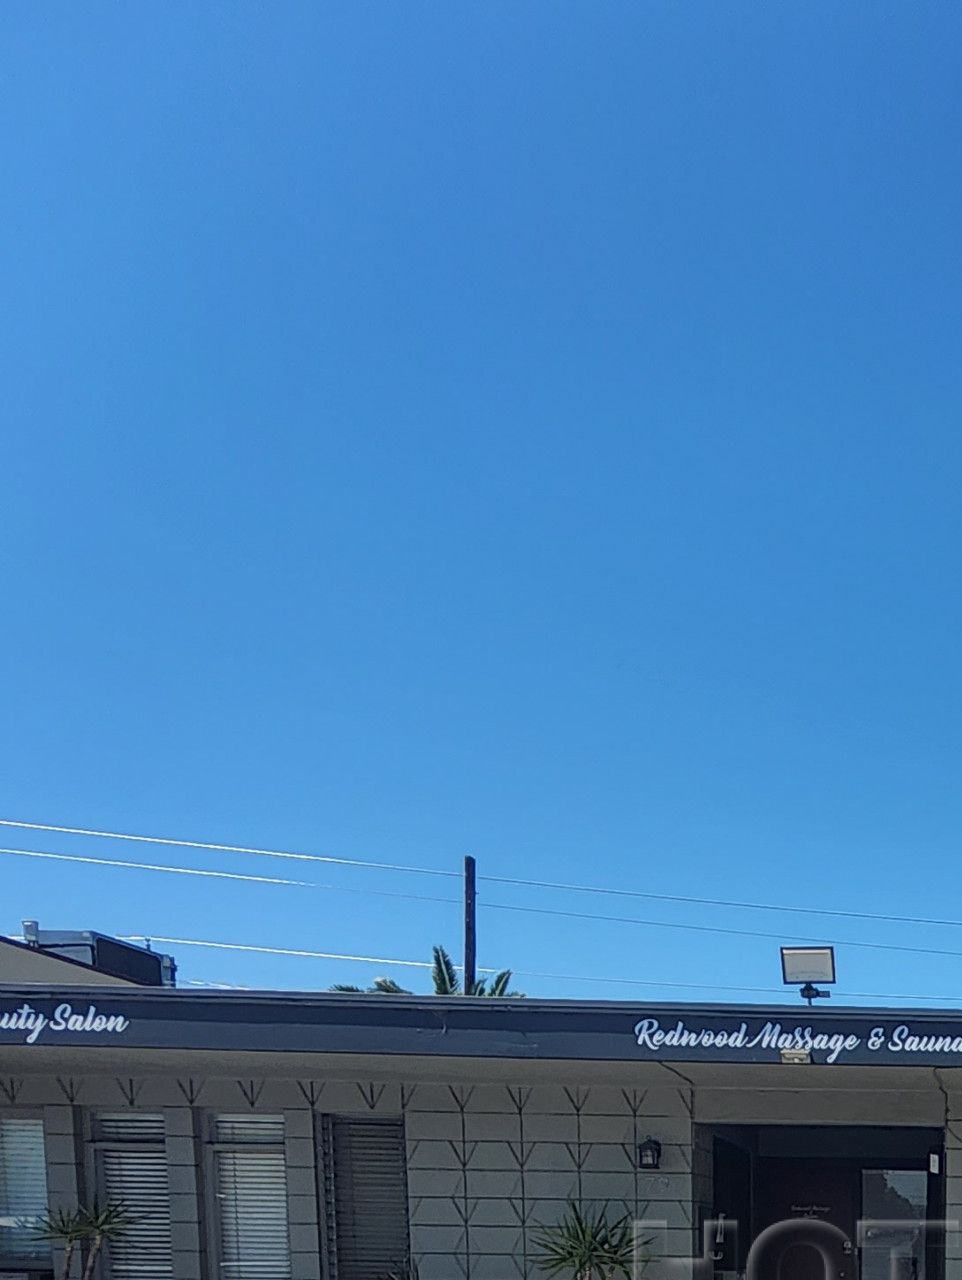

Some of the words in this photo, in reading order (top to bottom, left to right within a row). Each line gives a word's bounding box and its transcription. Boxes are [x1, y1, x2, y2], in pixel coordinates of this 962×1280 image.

[49, 1003, 130, 1032] Salon
[634, 1018, 749, 1050] Redwood
[746, 1021, 861, 1064] Massage
[867, 1027, 885, 1051] &
